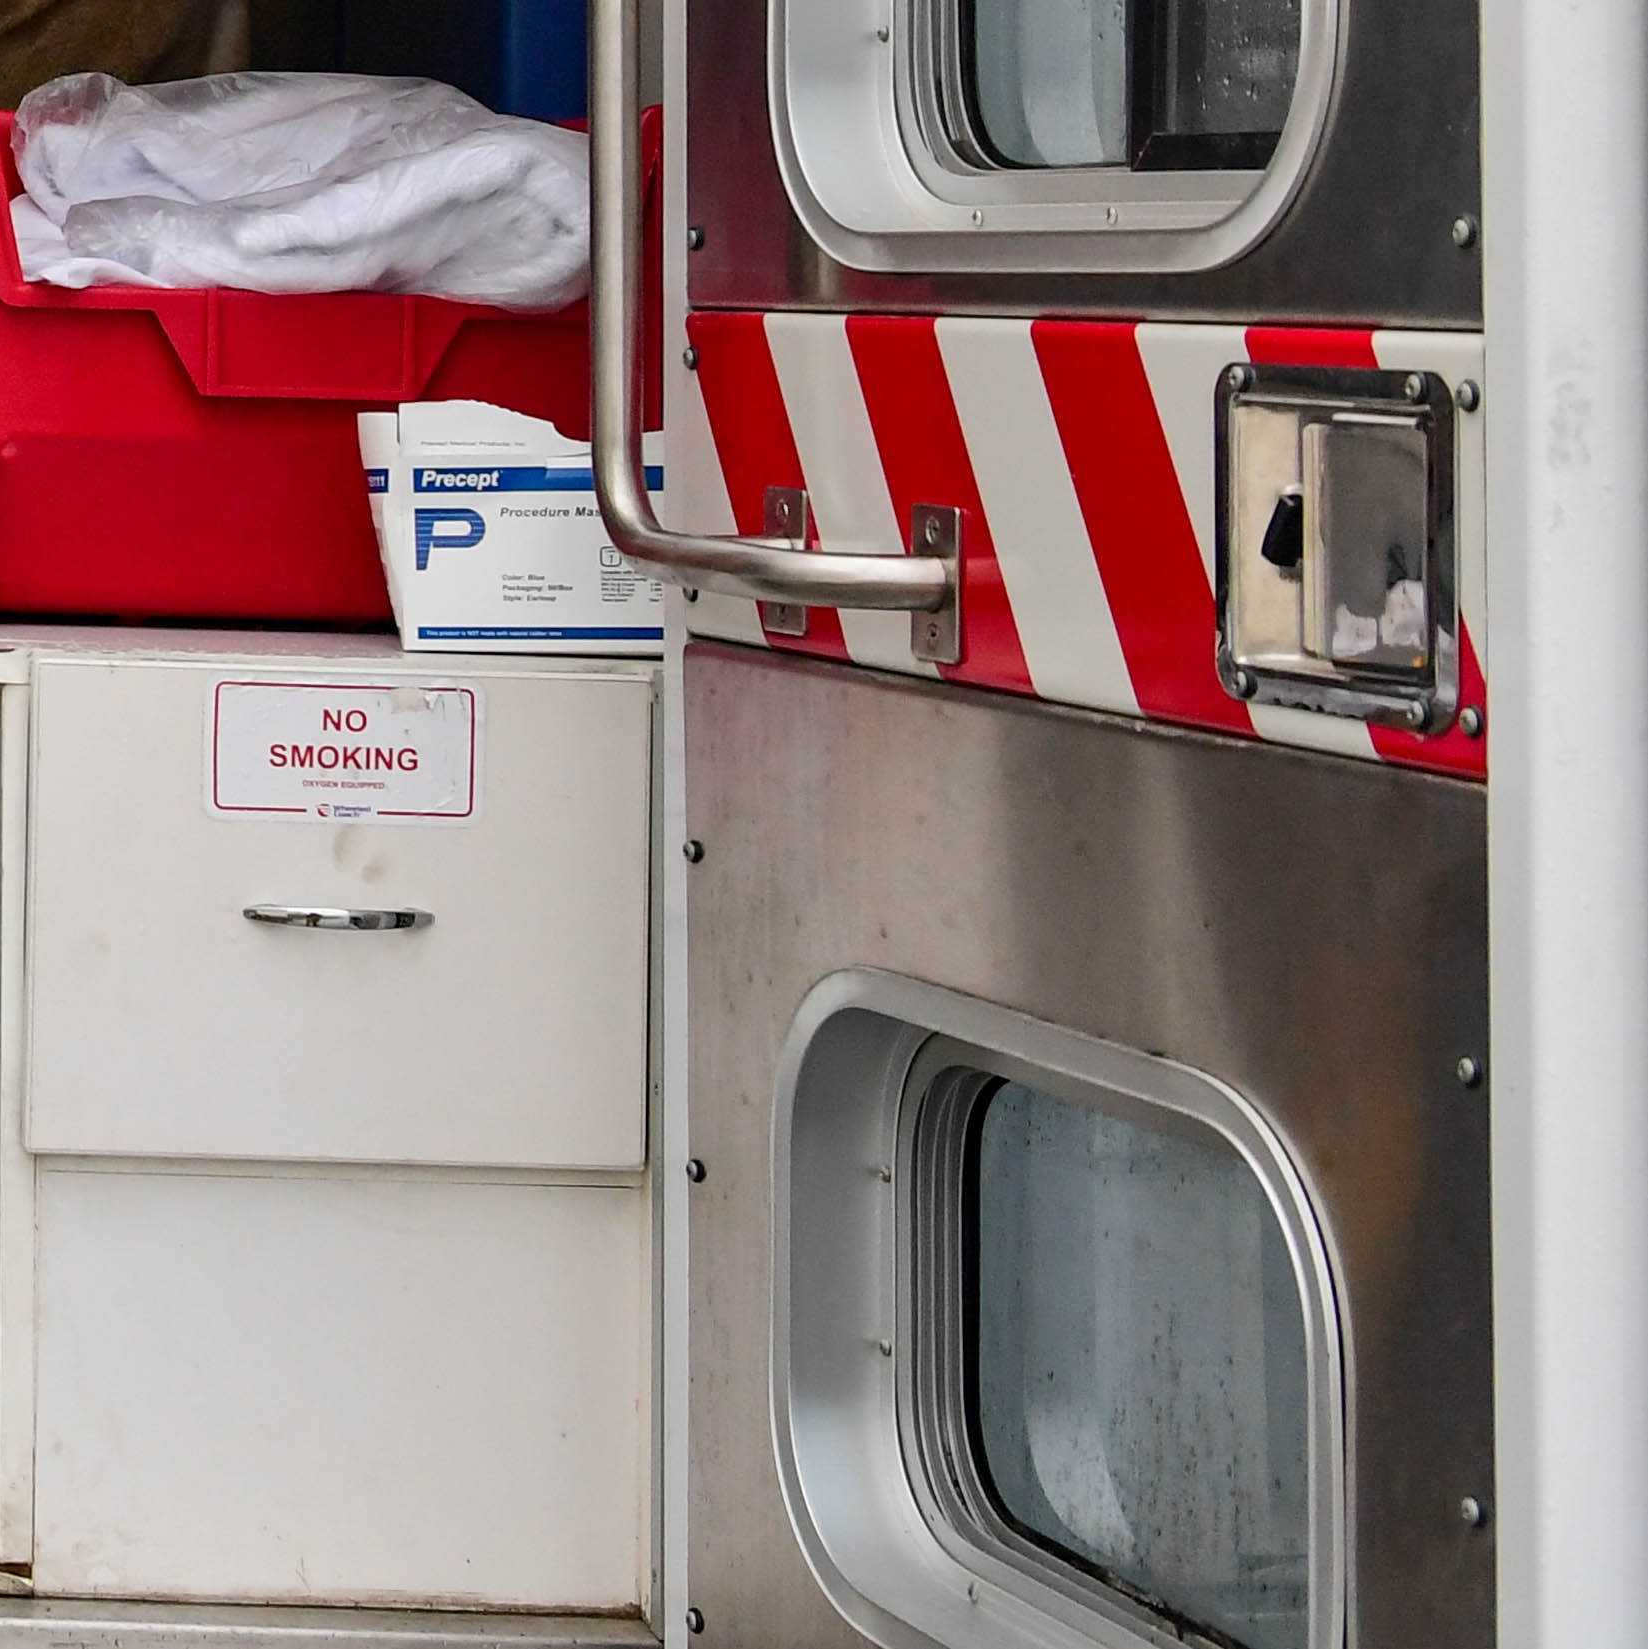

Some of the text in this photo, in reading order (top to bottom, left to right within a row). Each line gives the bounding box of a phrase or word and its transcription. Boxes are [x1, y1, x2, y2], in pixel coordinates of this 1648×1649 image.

[421, 470, 500, 491] Precept
[500, 506, 570, 518] Procedure
[414, 508, 486, 570] P
[322, 709, 367, 732] NO
[269, 744, 419, 772] SMOKING
[302, 780, 338, 789] OXYGEN
